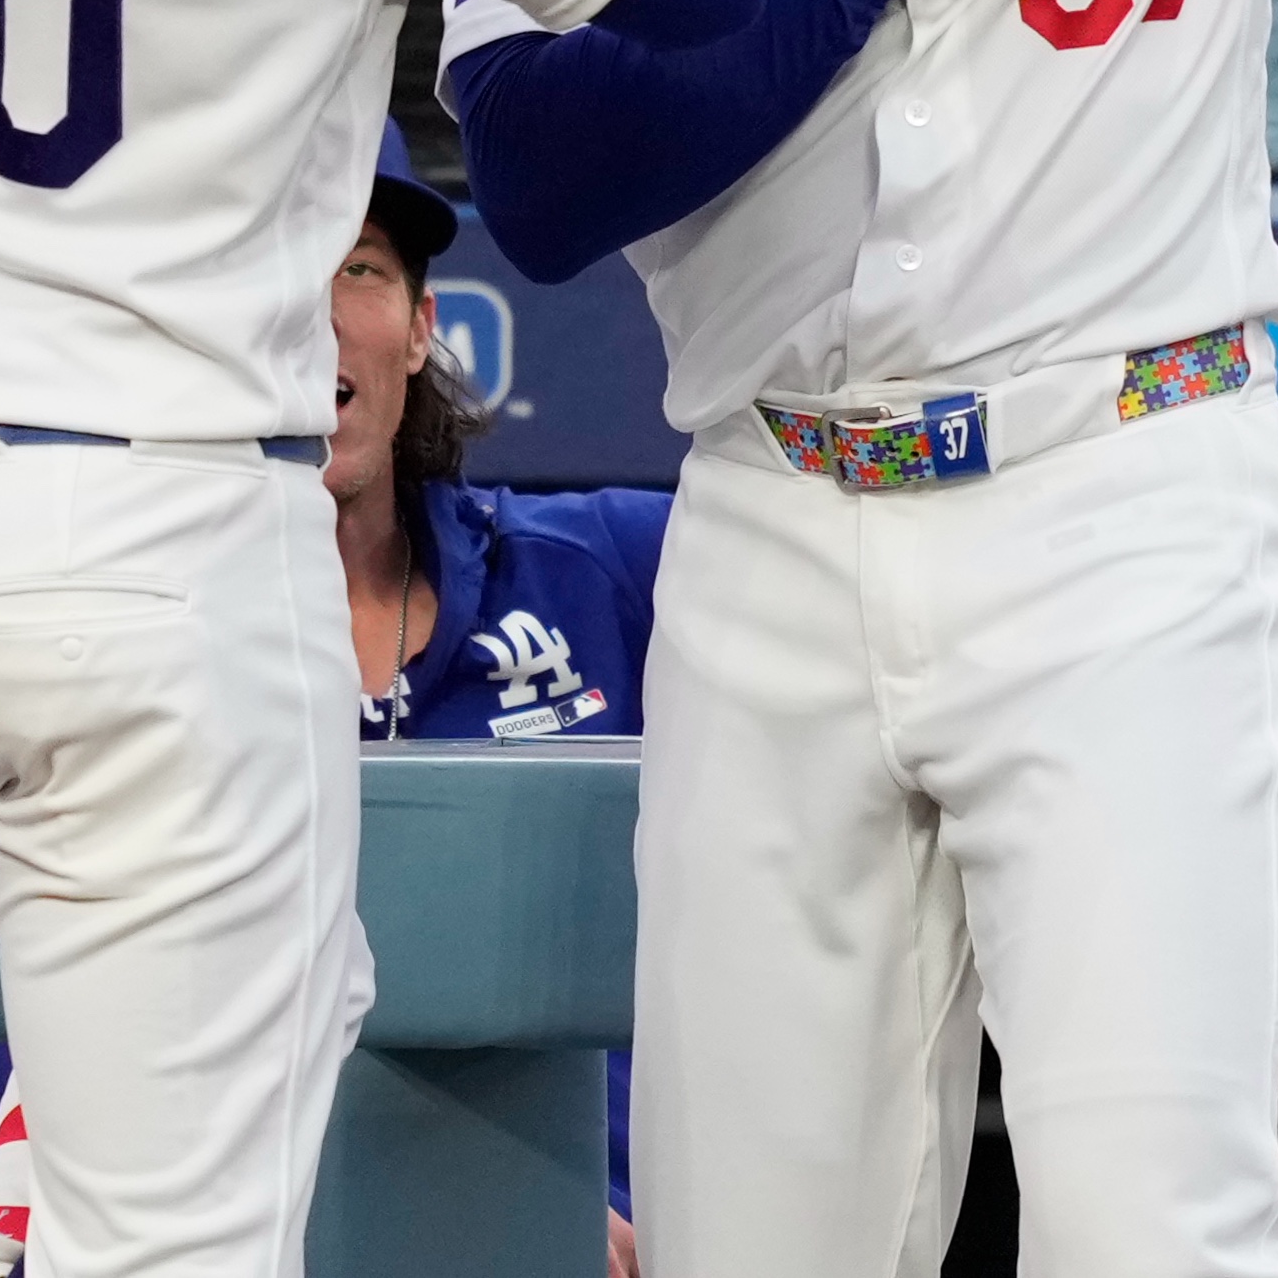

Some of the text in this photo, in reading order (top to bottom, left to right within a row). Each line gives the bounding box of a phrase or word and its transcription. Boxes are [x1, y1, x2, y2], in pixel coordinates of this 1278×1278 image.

[939, 417, 969, 461] 37
[470, 610, 584, 709] LA
[495, 713, 555, 736] DODGERS
